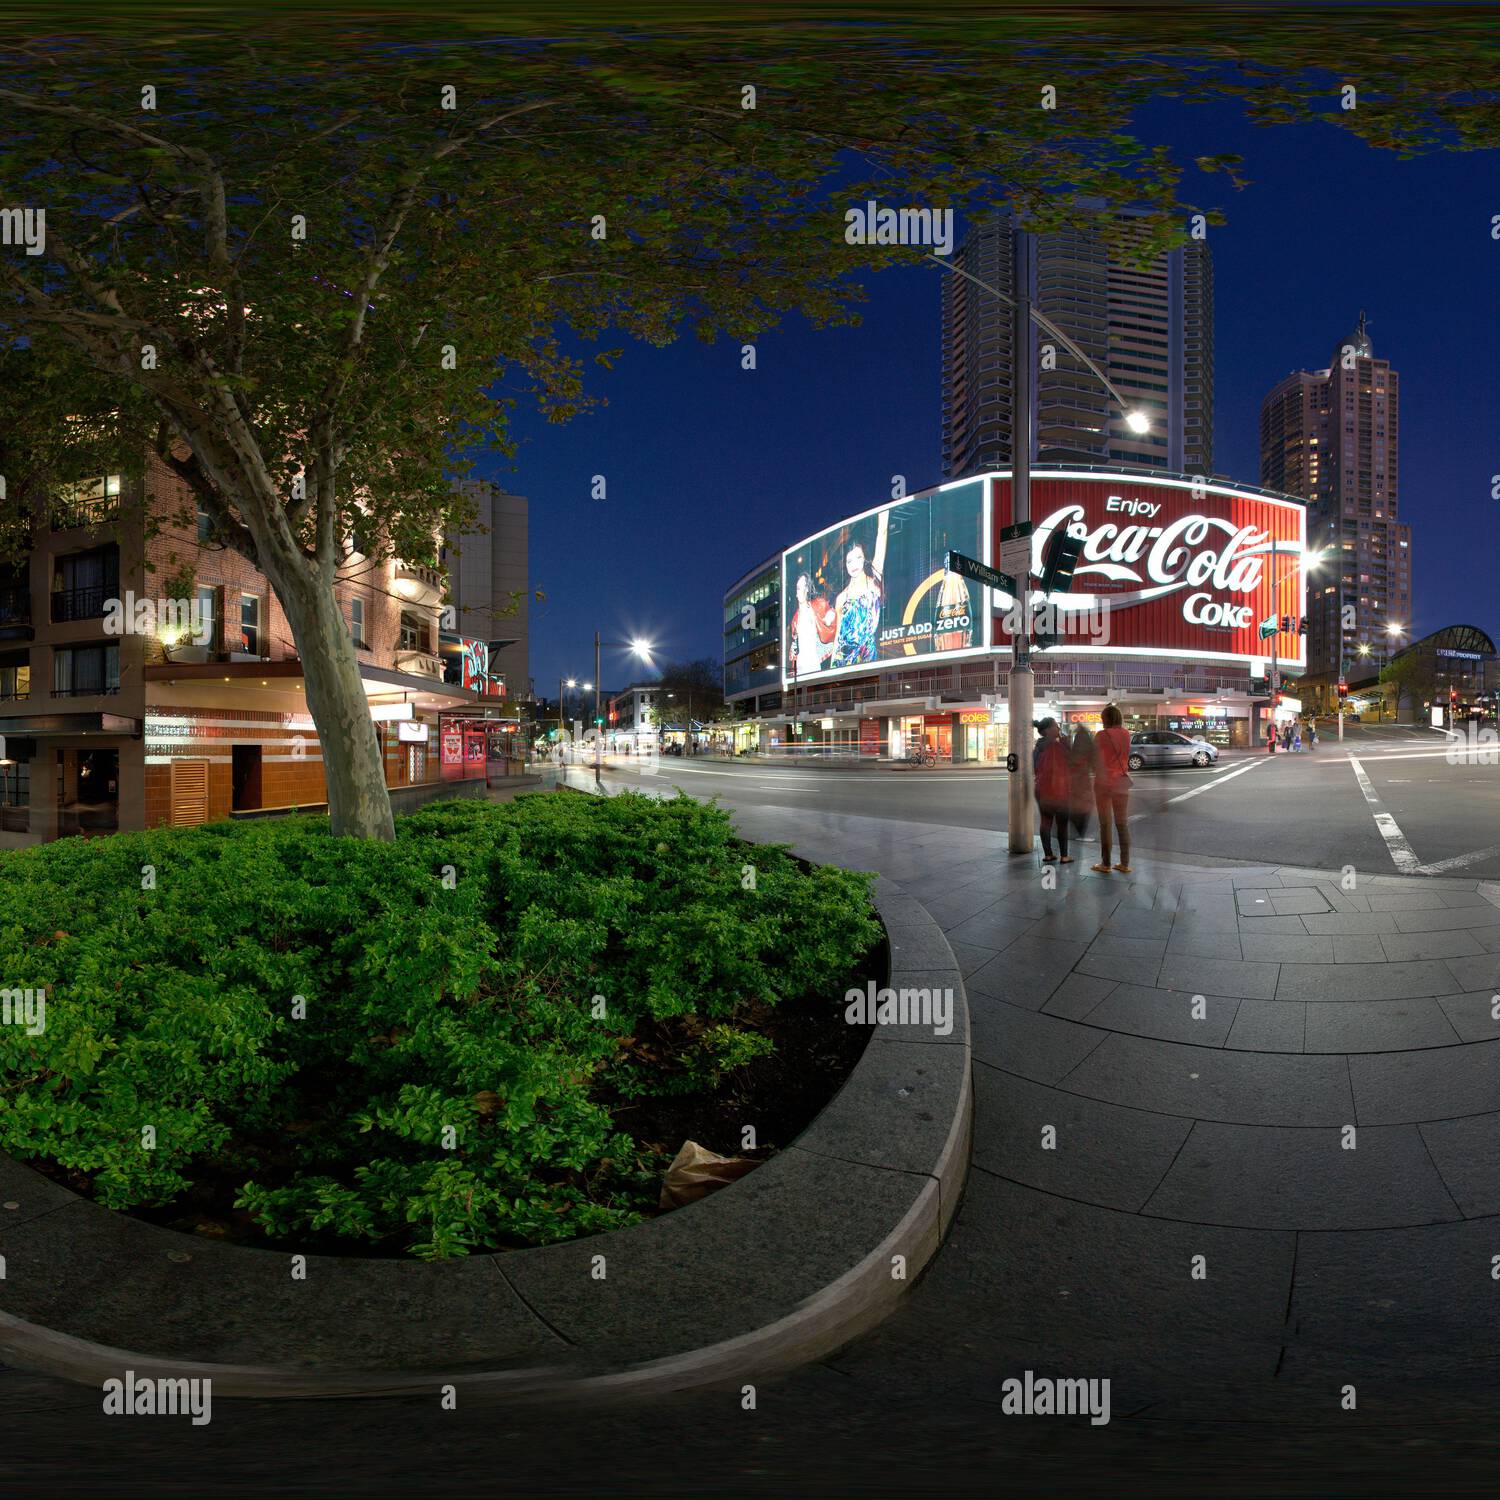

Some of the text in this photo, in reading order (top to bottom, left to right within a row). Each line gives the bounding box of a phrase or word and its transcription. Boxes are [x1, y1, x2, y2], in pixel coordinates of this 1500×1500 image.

[1106, 495, 1161, 518] Enjoy
[1031, 504, 1269, 593] Coca-Cola
[967, 560, 999, 583] William
[1182, 592, 1253, 628] Coke
[879, 615, 970, 641] JUST ADD zero
[961, 712, 990, 723] coles
[1071, 712, 1102, 723] coles
